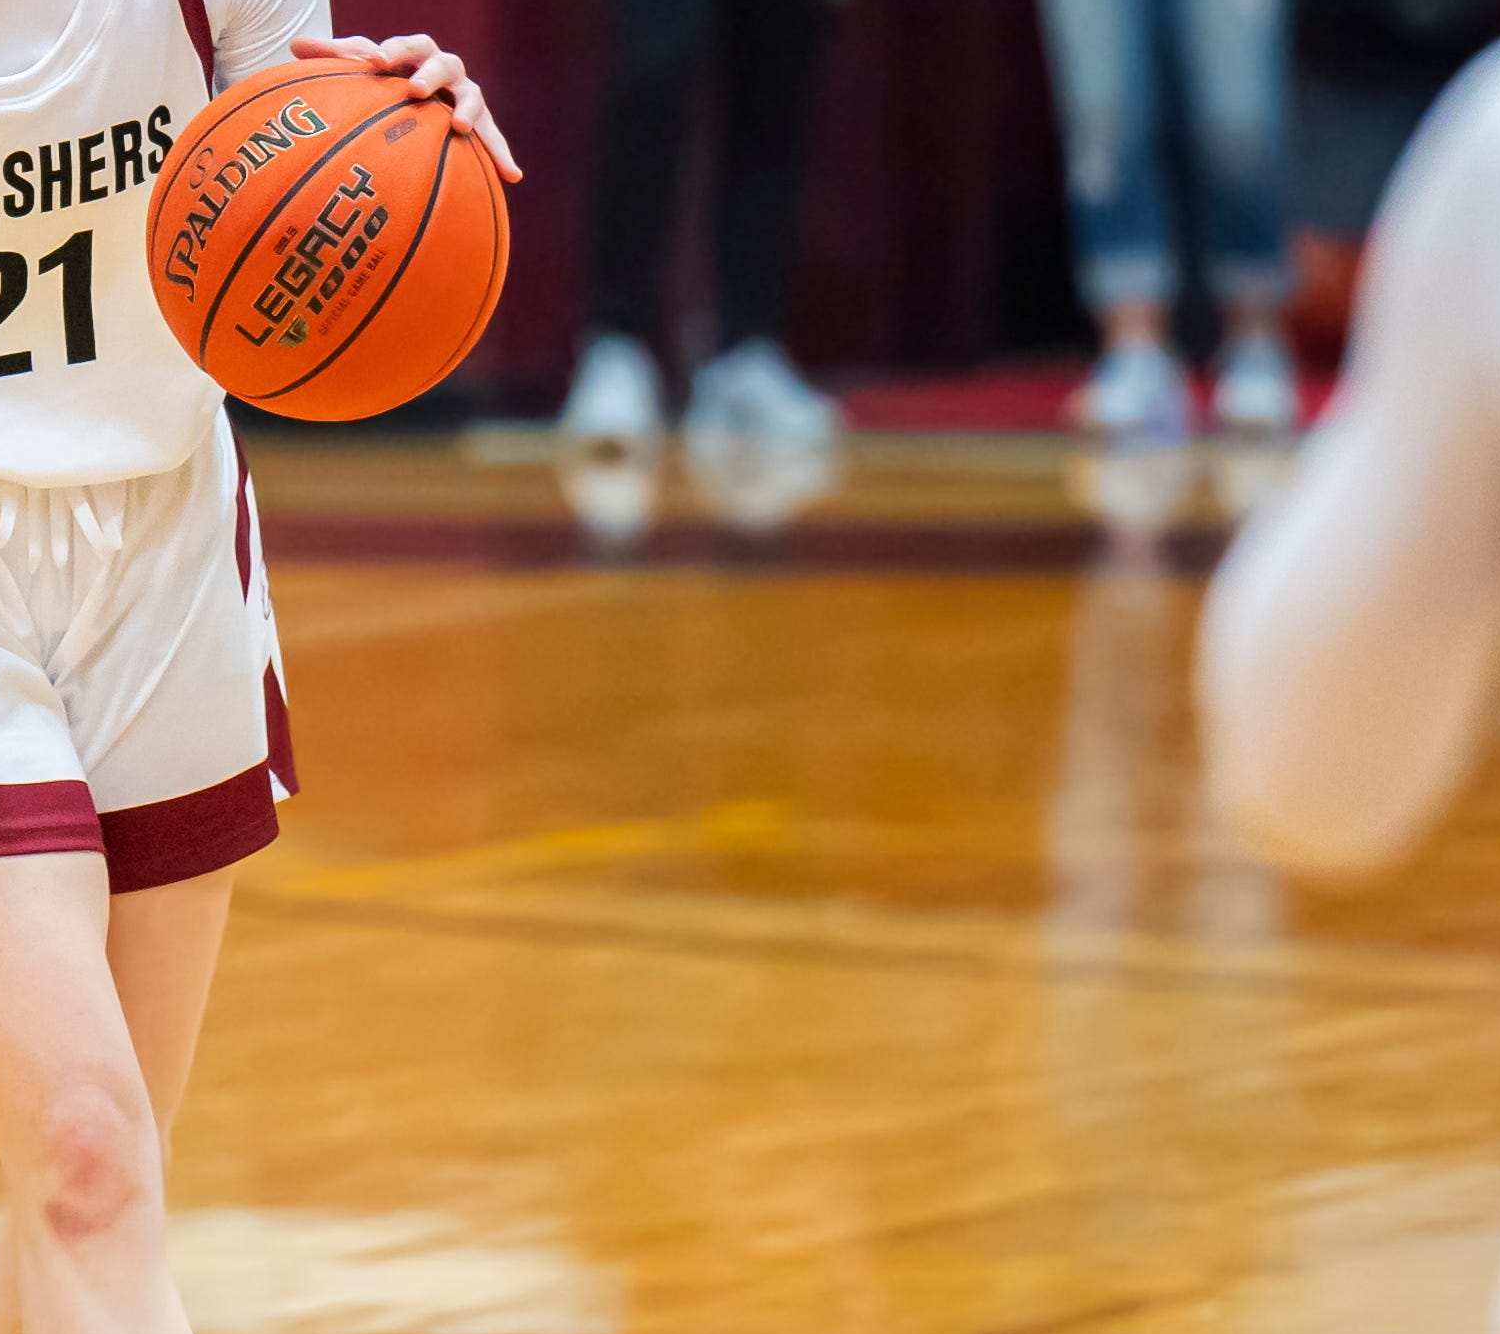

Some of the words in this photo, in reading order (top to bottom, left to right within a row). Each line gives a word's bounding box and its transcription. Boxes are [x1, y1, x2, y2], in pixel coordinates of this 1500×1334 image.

[165, 97, 331, 303] SPALDING
[235, 163, 376, 347] LEGACY
[305, 205, 389, 315] 1000
[318, 298, 351, 336] OFFICIAL
[347, 272, 369, 298] GAME
[366, 249, 387, 271] BALL
